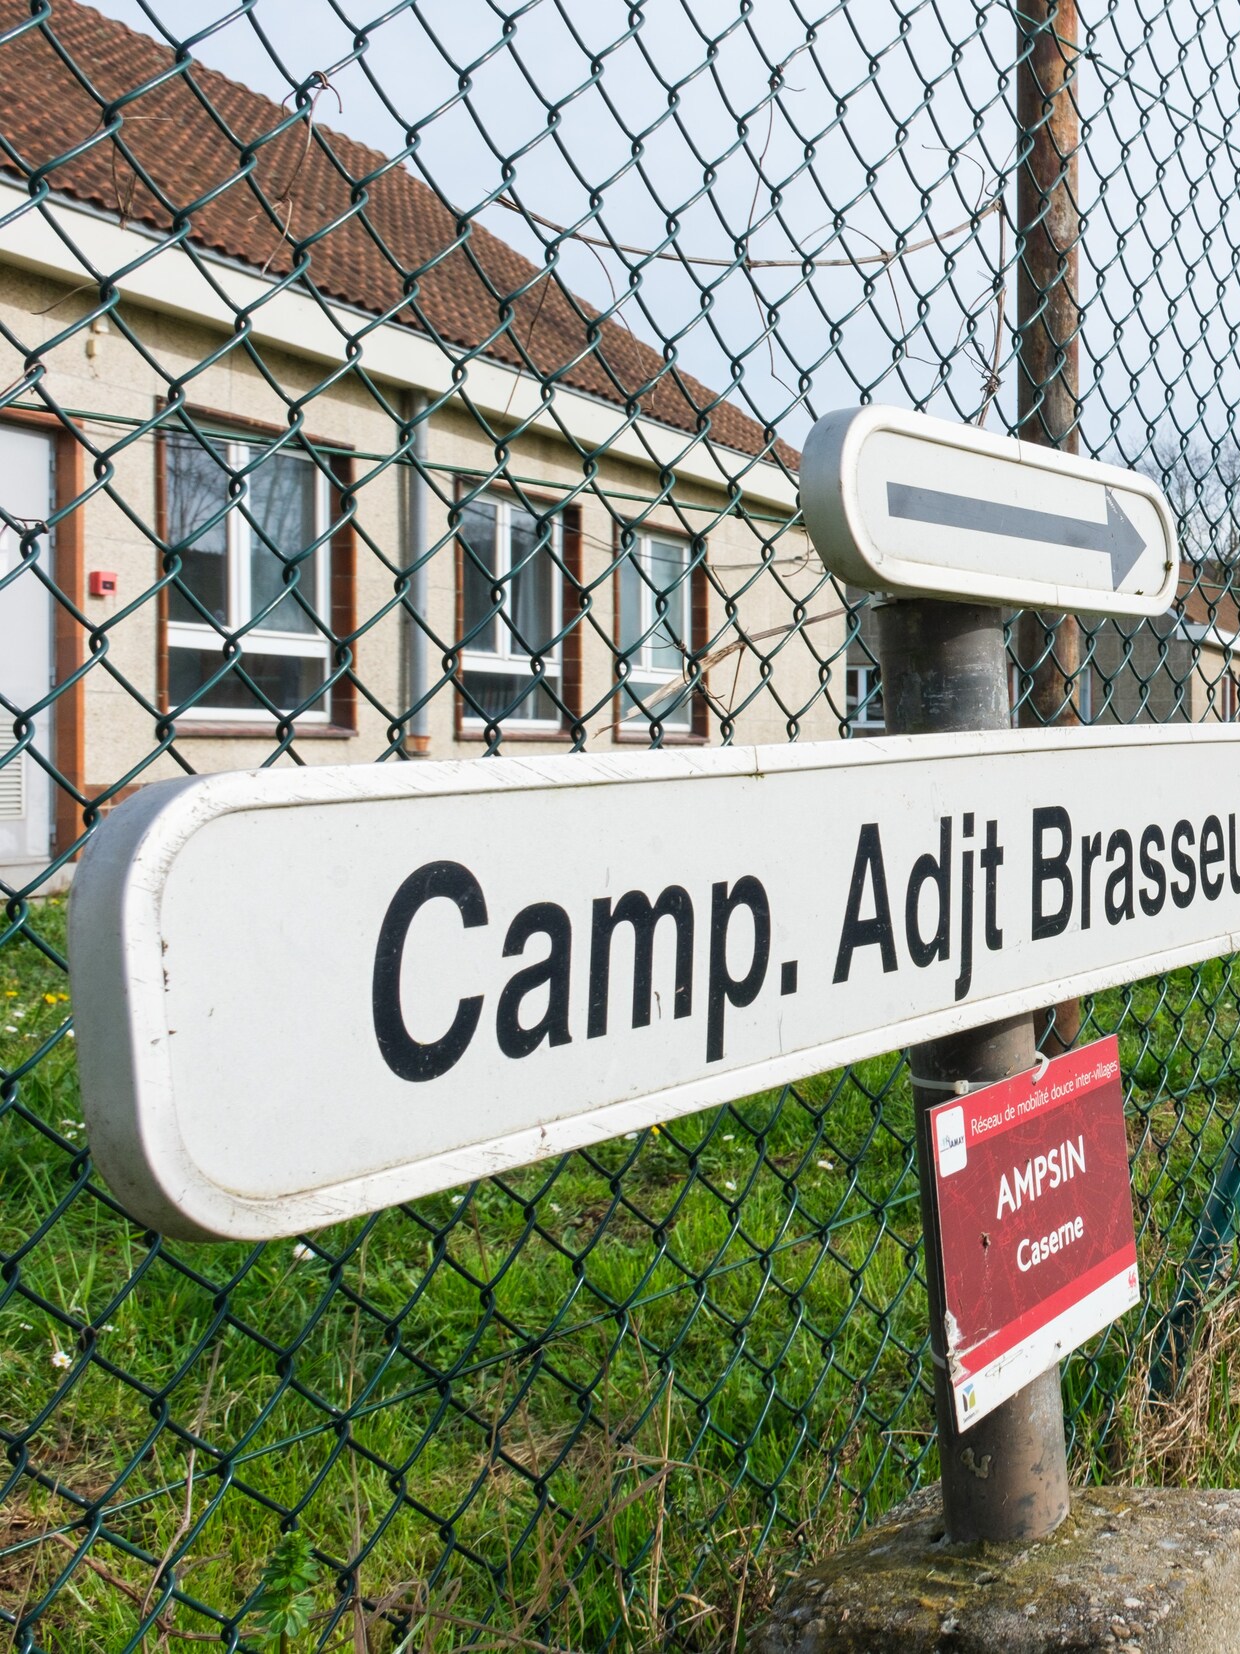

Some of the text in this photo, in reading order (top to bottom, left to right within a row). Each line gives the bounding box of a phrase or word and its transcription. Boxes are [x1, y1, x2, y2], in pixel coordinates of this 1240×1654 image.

[371, 859, 798, 1083] Camp.
[831, 812, 1004, 1002] Adjt
[971, 1059, 1119, 1137] Réseau de mobilité douce inter-villages
[996, 1134, 1087, 1220] AMPSIN
[1016, 1215, 1085, 1272] Caserne
